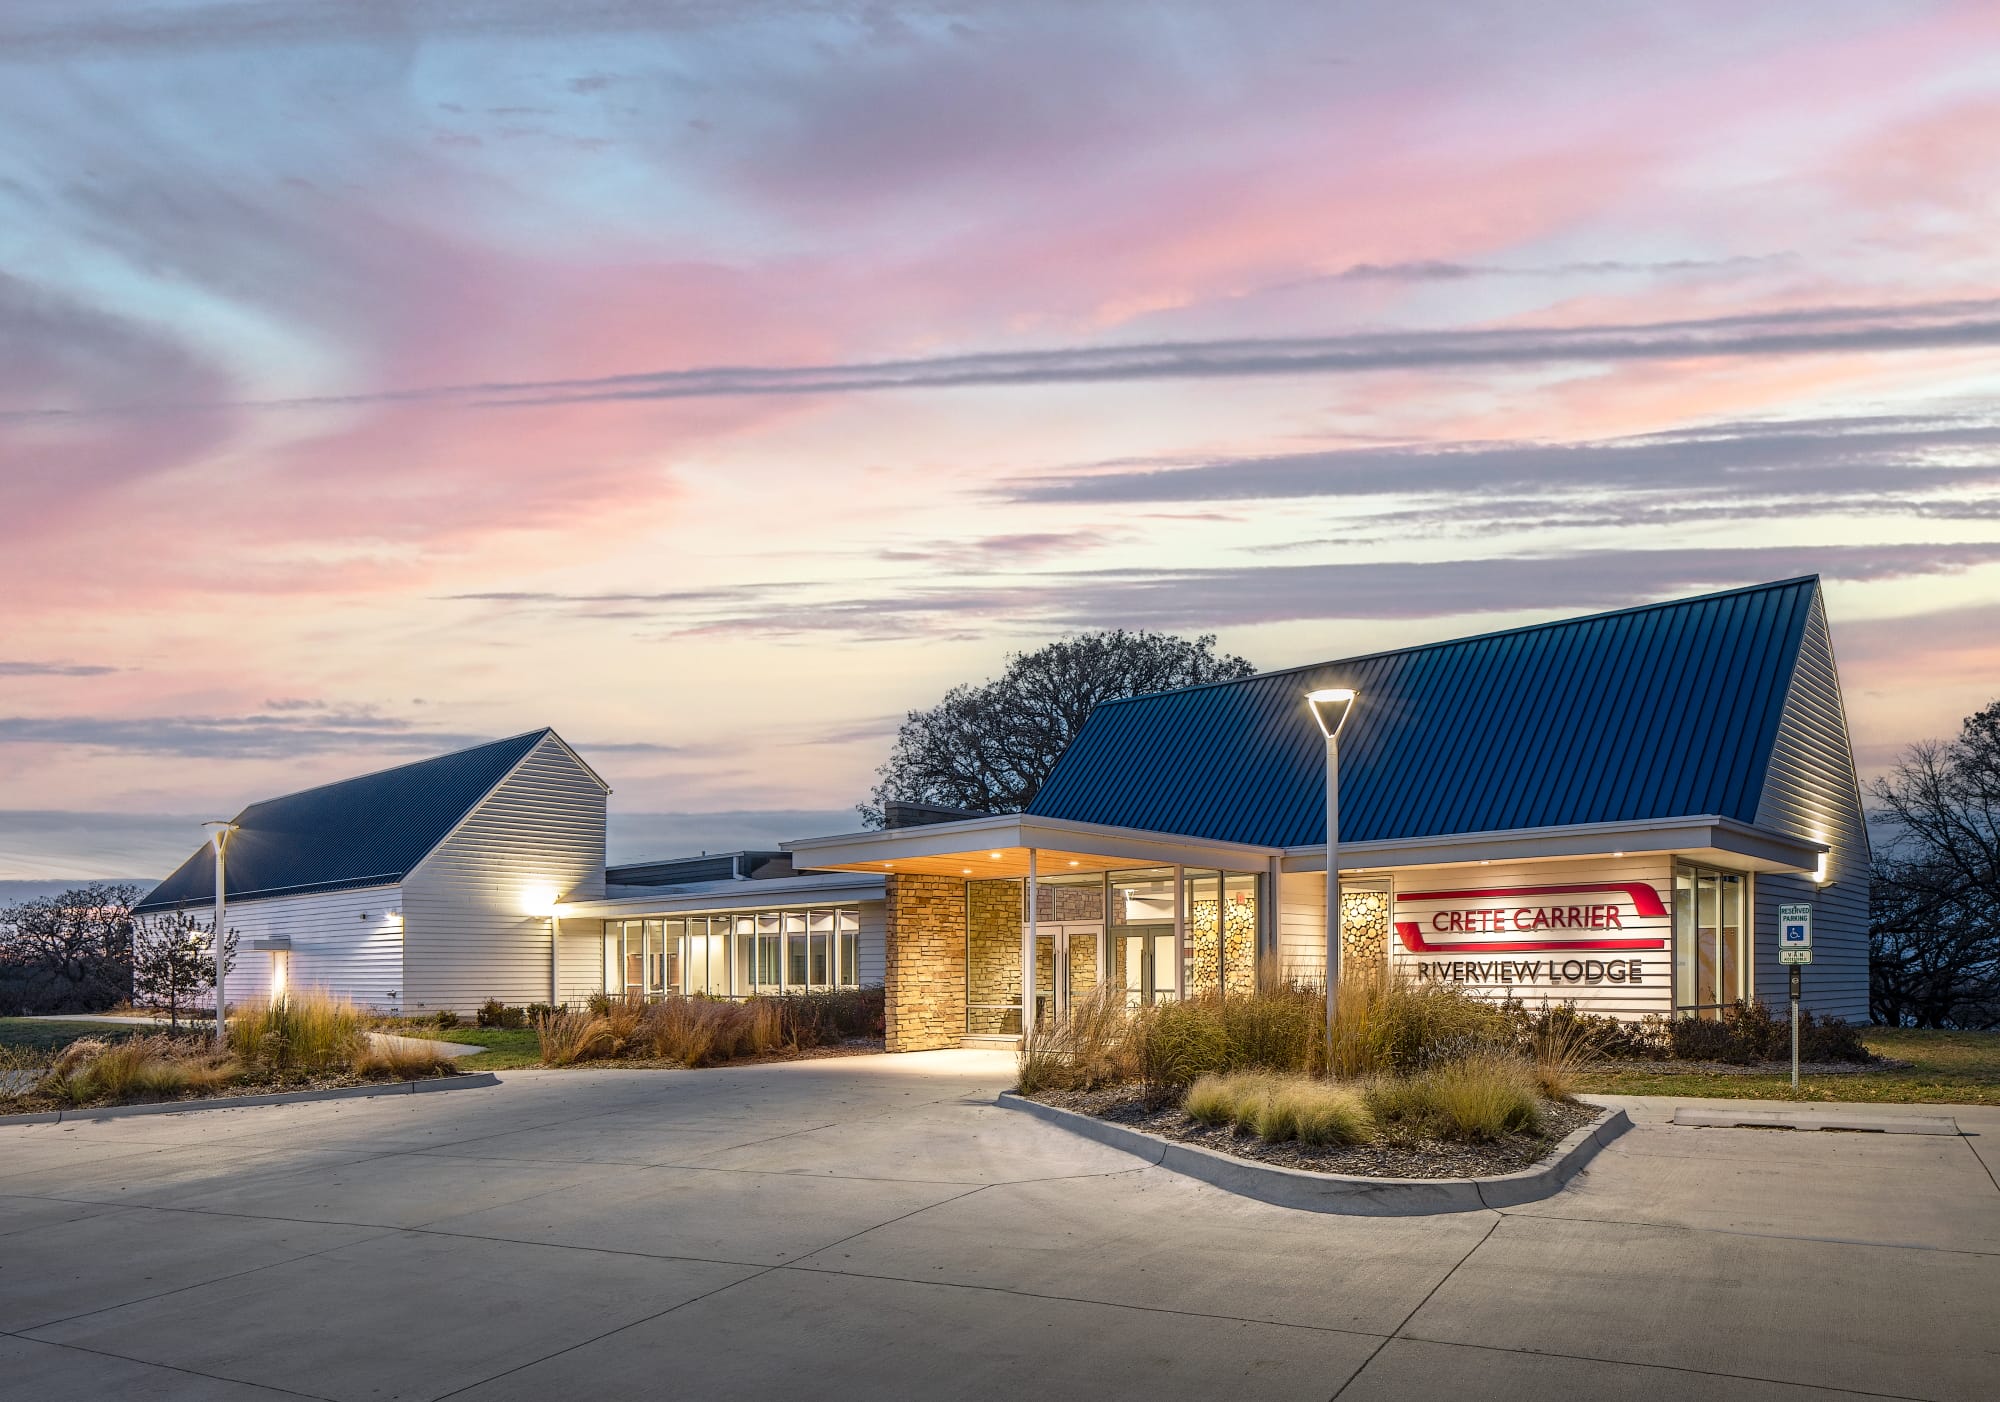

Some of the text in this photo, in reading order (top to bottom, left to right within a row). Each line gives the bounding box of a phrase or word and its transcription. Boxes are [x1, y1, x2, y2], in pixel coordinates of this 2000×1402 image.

[1432, 905, 1622, 932] CRETE CARRIER
[1418, 959, 1642, 983] RIVERVIEW LODGE
